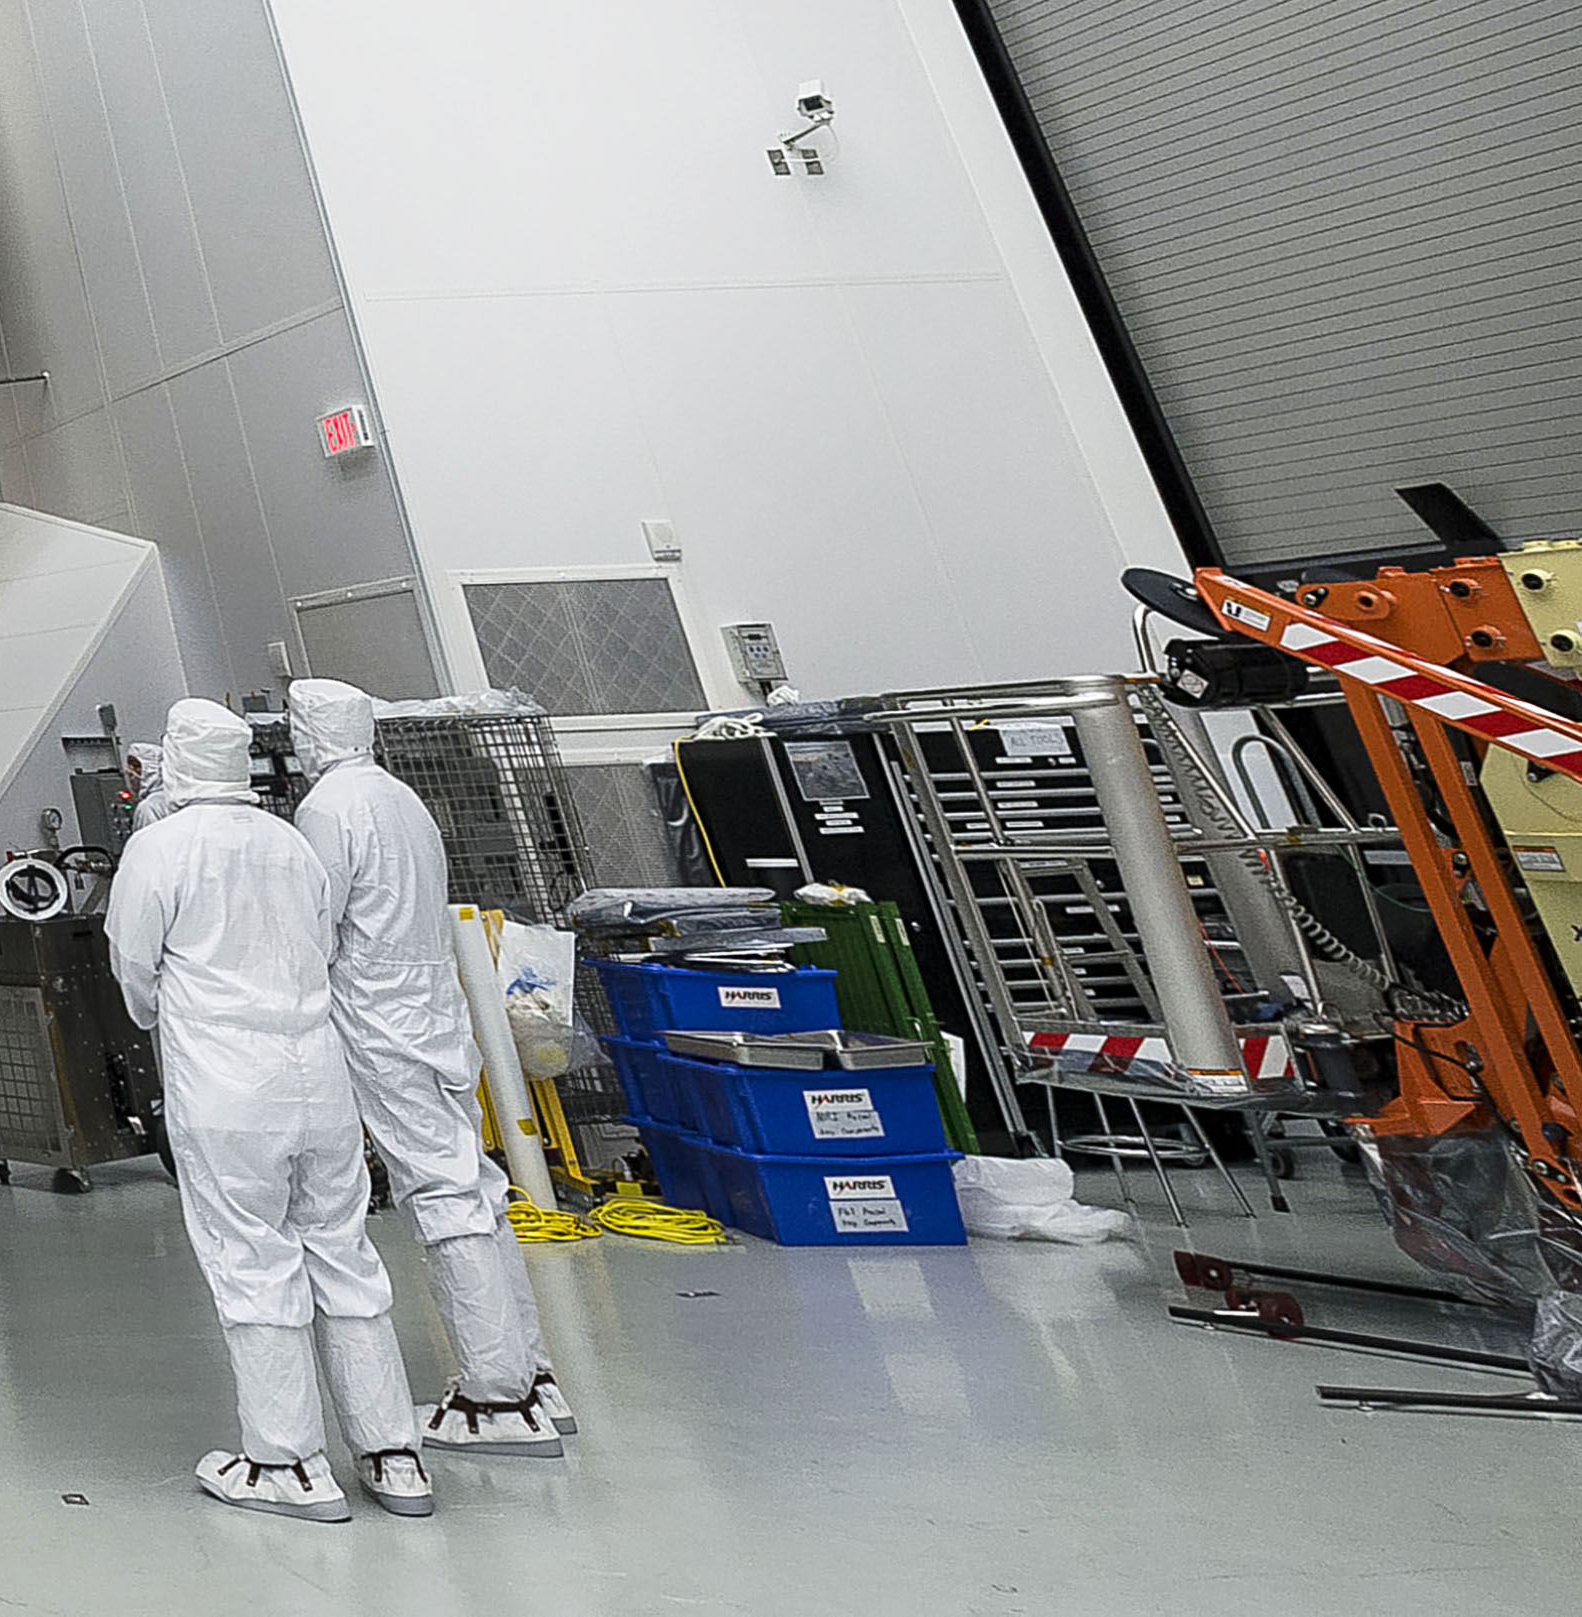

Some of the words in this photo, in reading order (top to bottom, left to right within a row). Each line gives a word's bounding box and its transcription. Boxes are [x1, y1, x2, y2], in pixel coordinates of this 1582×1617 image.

[322, 411, 356, 454] EXIT
[724, 991, 775, 1002] HARRIS
[811, 1093, 865, 1106] HARRIS
[832, 1180, 886, 1193] HARRIS
